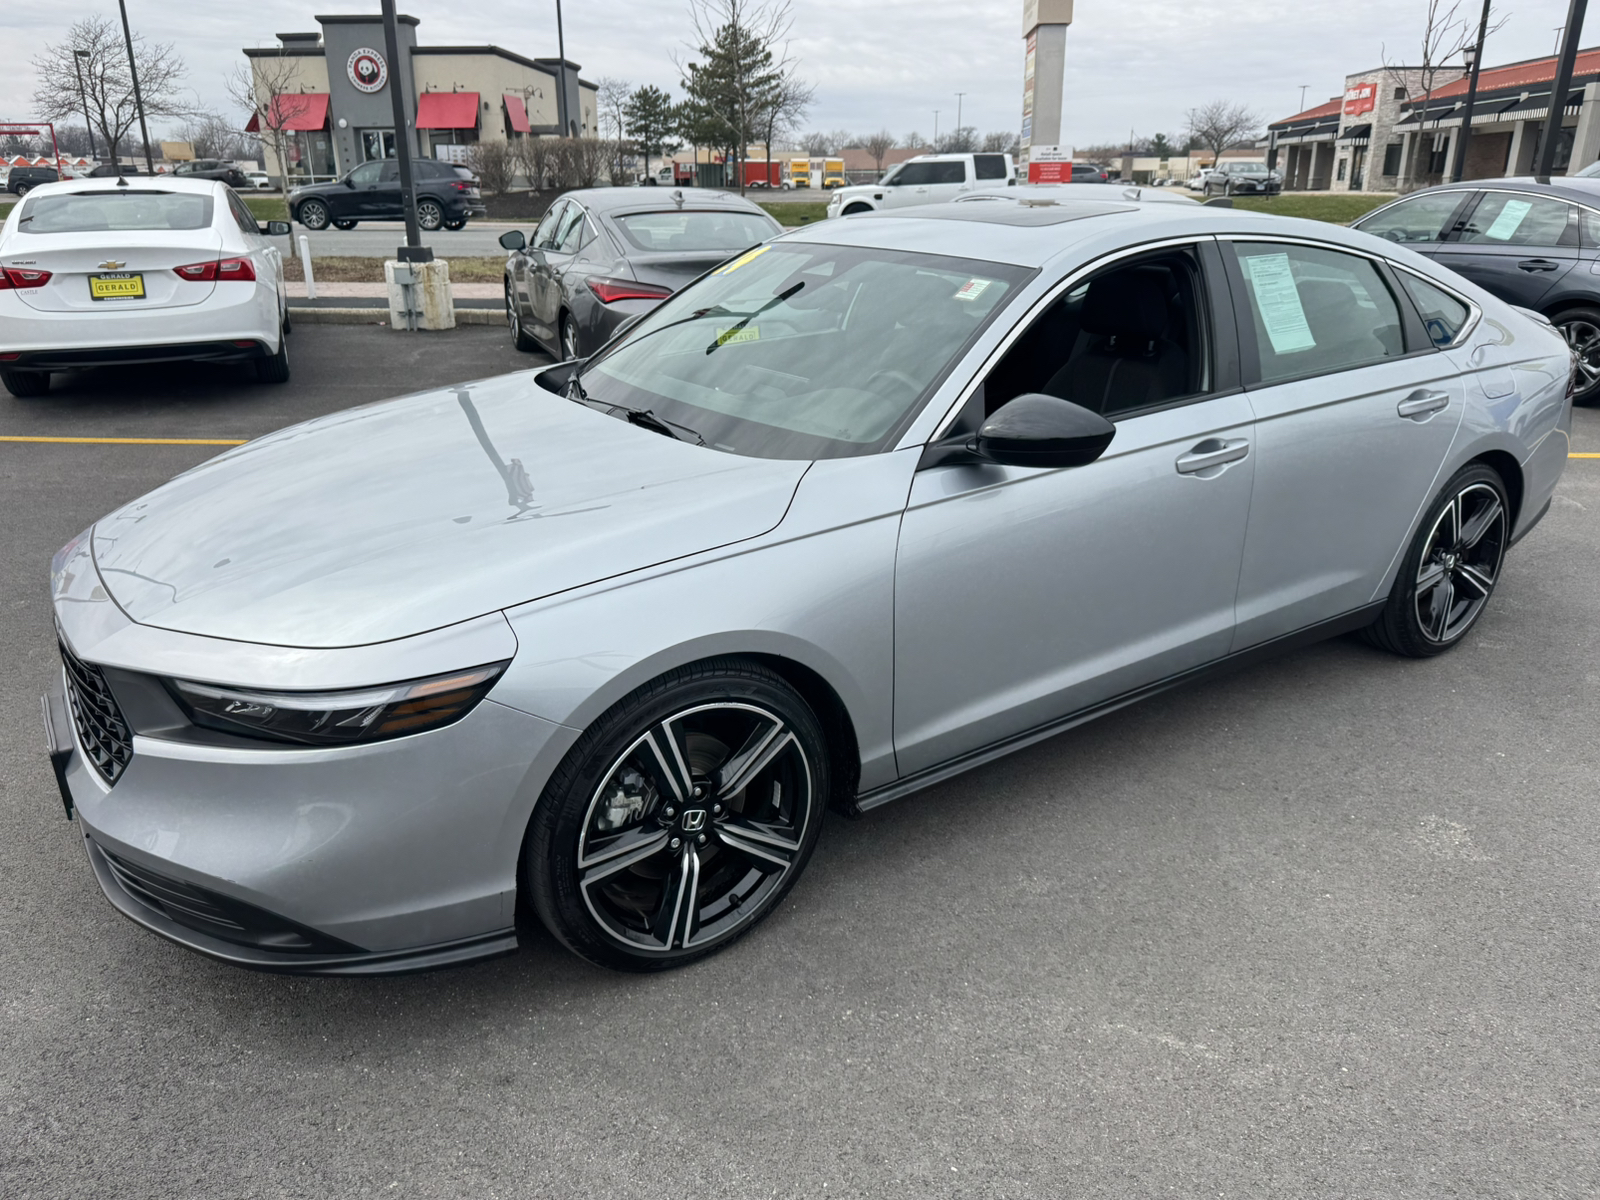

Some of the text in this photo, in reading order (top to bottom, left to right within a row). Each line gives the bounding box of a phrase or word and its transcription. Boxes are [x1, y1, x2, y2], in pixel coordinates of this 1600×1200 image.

[348, 49, 385, 69] PANDA EXPRESS
[98, 283, 136, 292] GERALD
